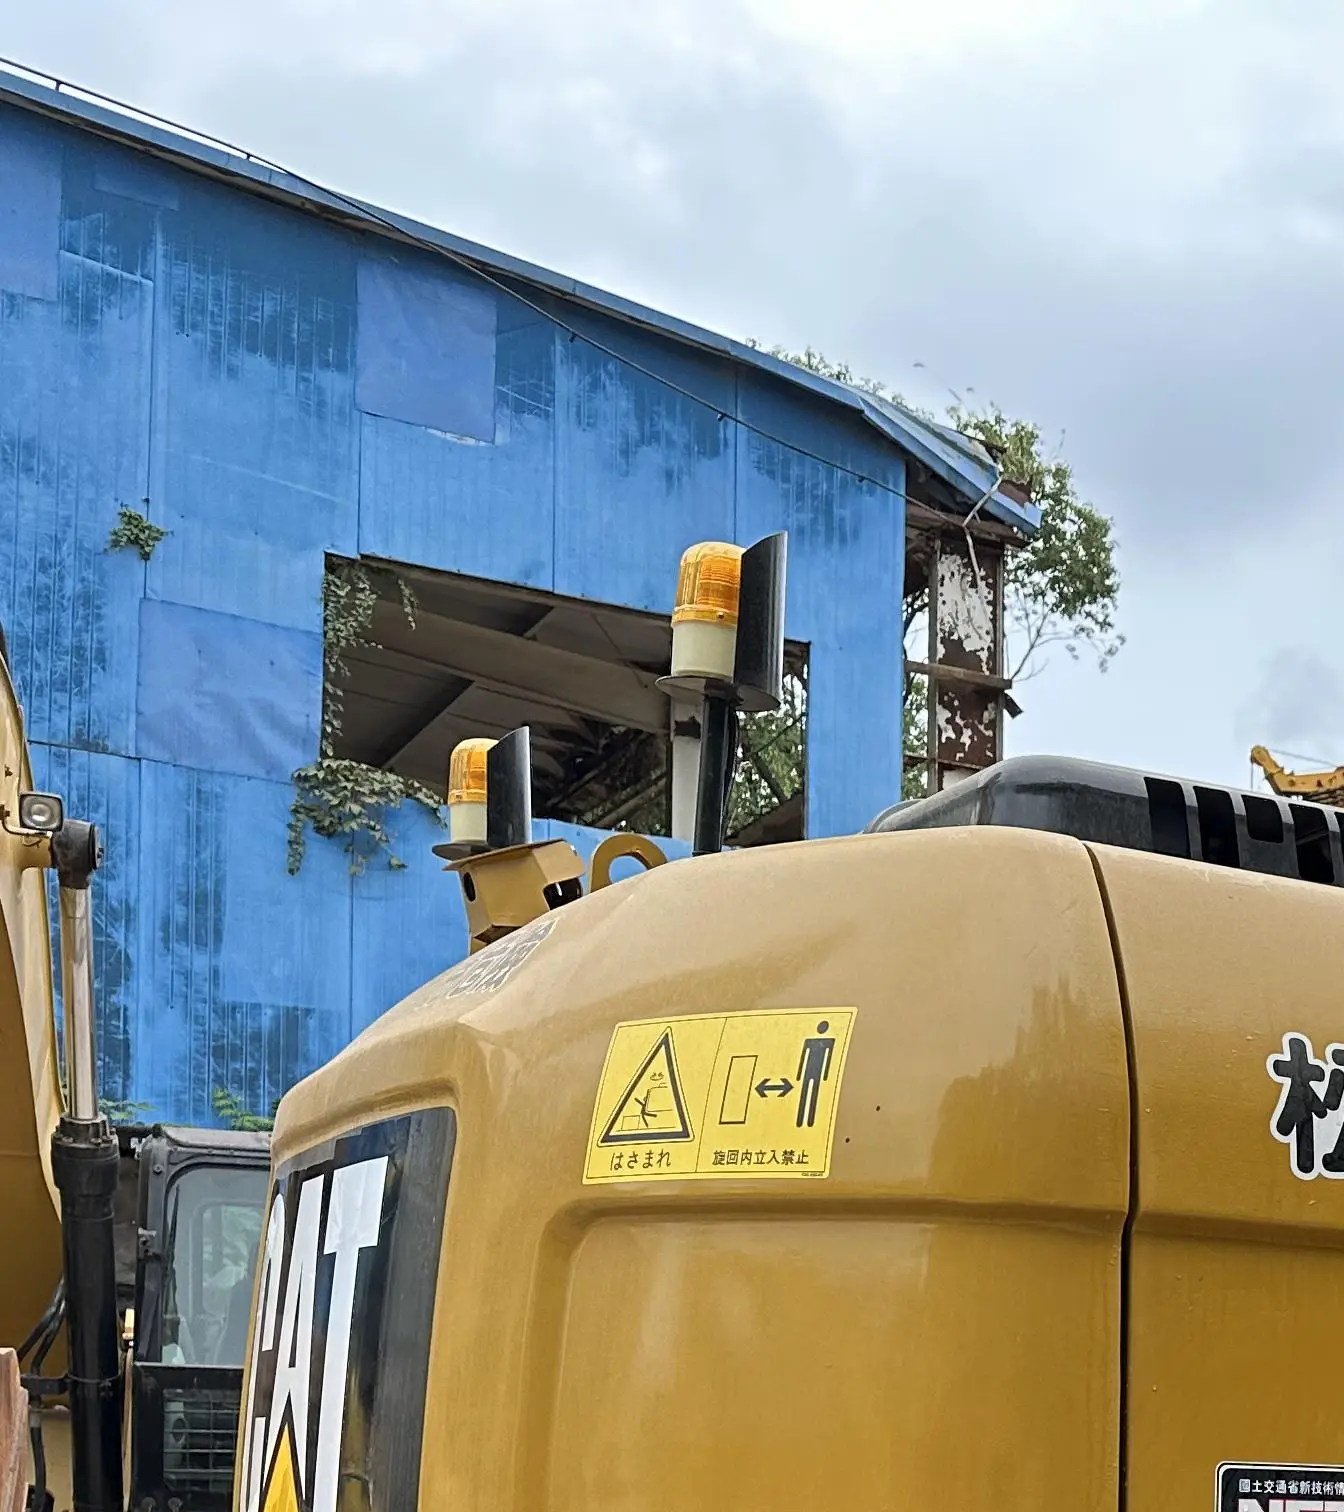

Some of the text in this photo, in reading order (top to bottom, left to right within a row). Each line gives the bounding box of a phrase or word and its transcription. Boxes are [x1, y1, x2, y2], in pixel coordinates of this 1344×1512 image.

[609, 1151, 671, 1170] はさまれ
[712, 1149, 809, 1166] 旋回内立入禁止
